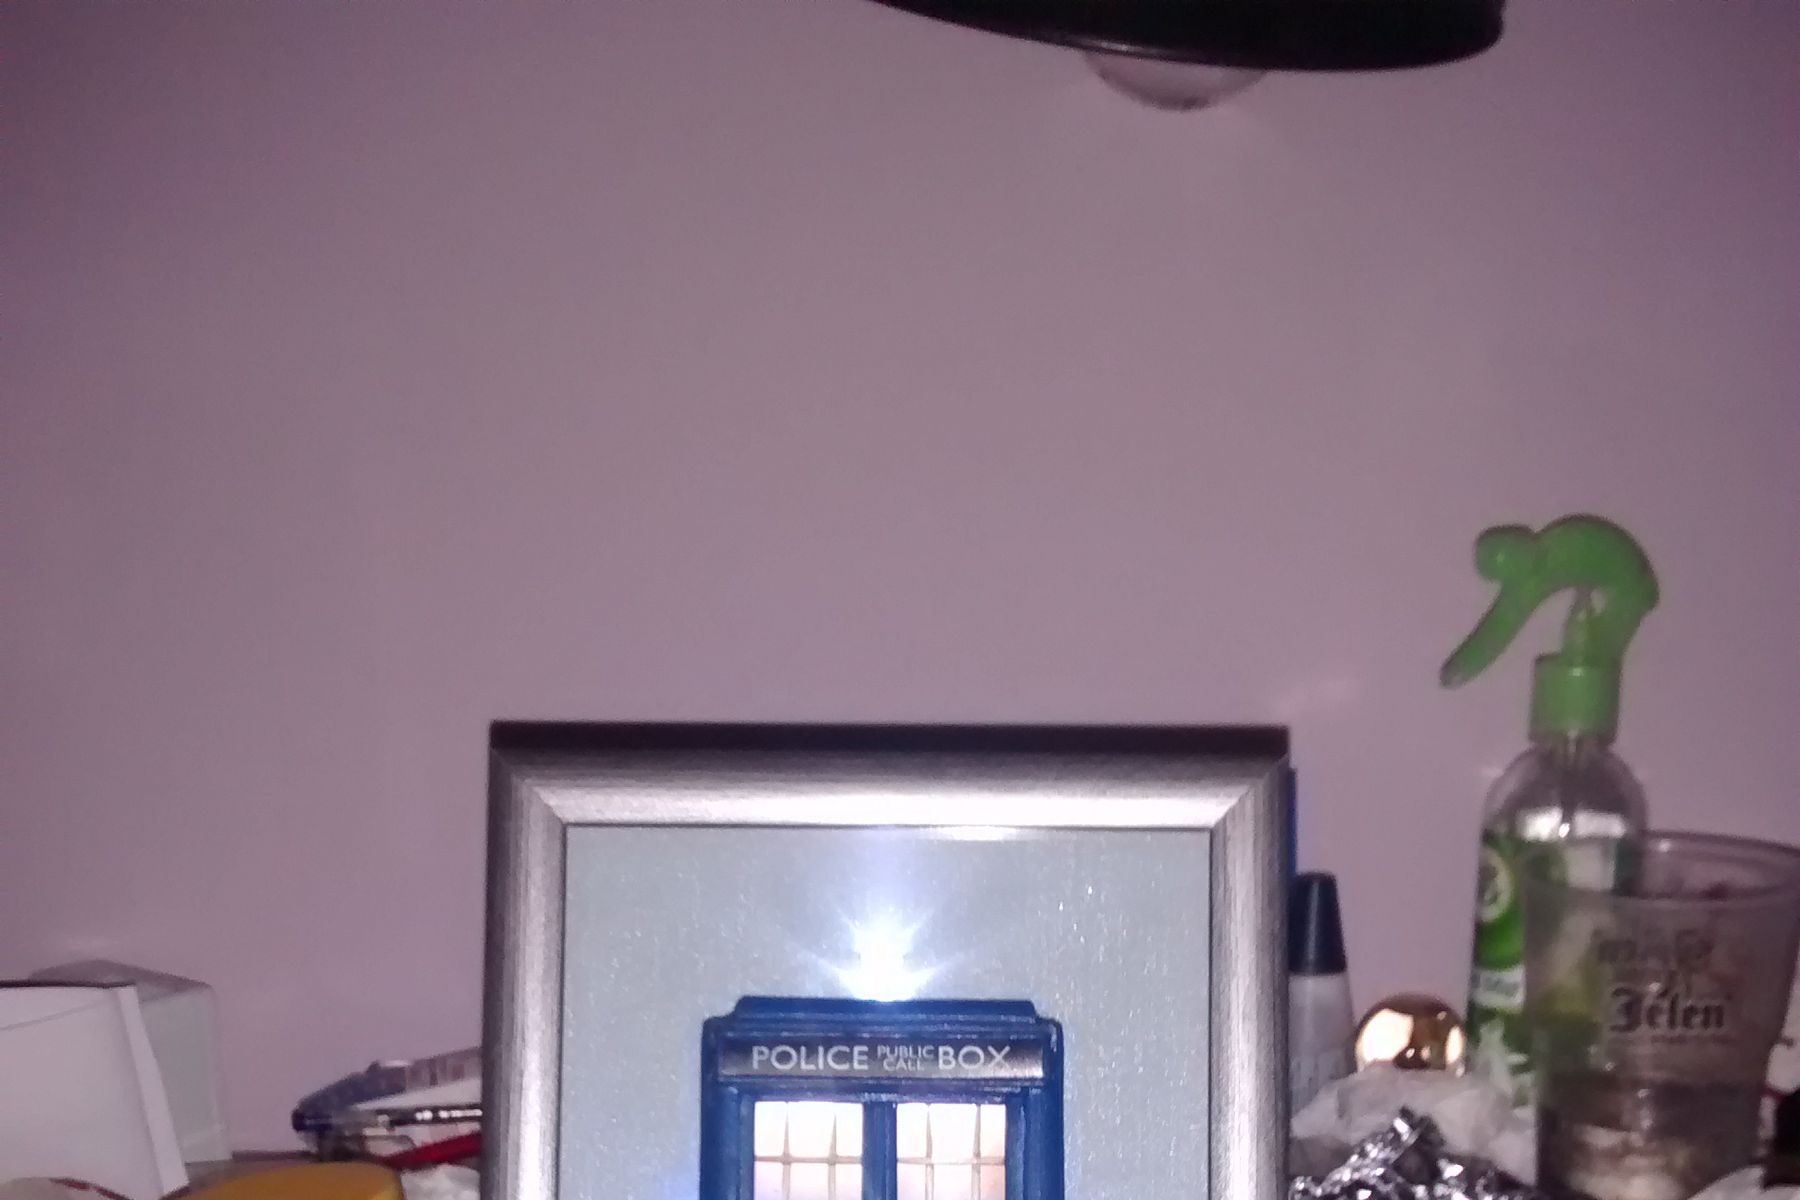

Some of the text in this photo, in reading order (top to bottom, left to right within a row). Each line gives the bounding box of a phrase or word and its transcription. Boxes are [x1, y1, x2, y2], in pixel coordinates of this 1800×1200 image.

[752, 1045, 869, 1070] POLICE
[877, 1044, 935, 1058] PUBLIC
[938, 1045, 1011, 1070] BOX
[883, 1059, 925, 1071] CALL
